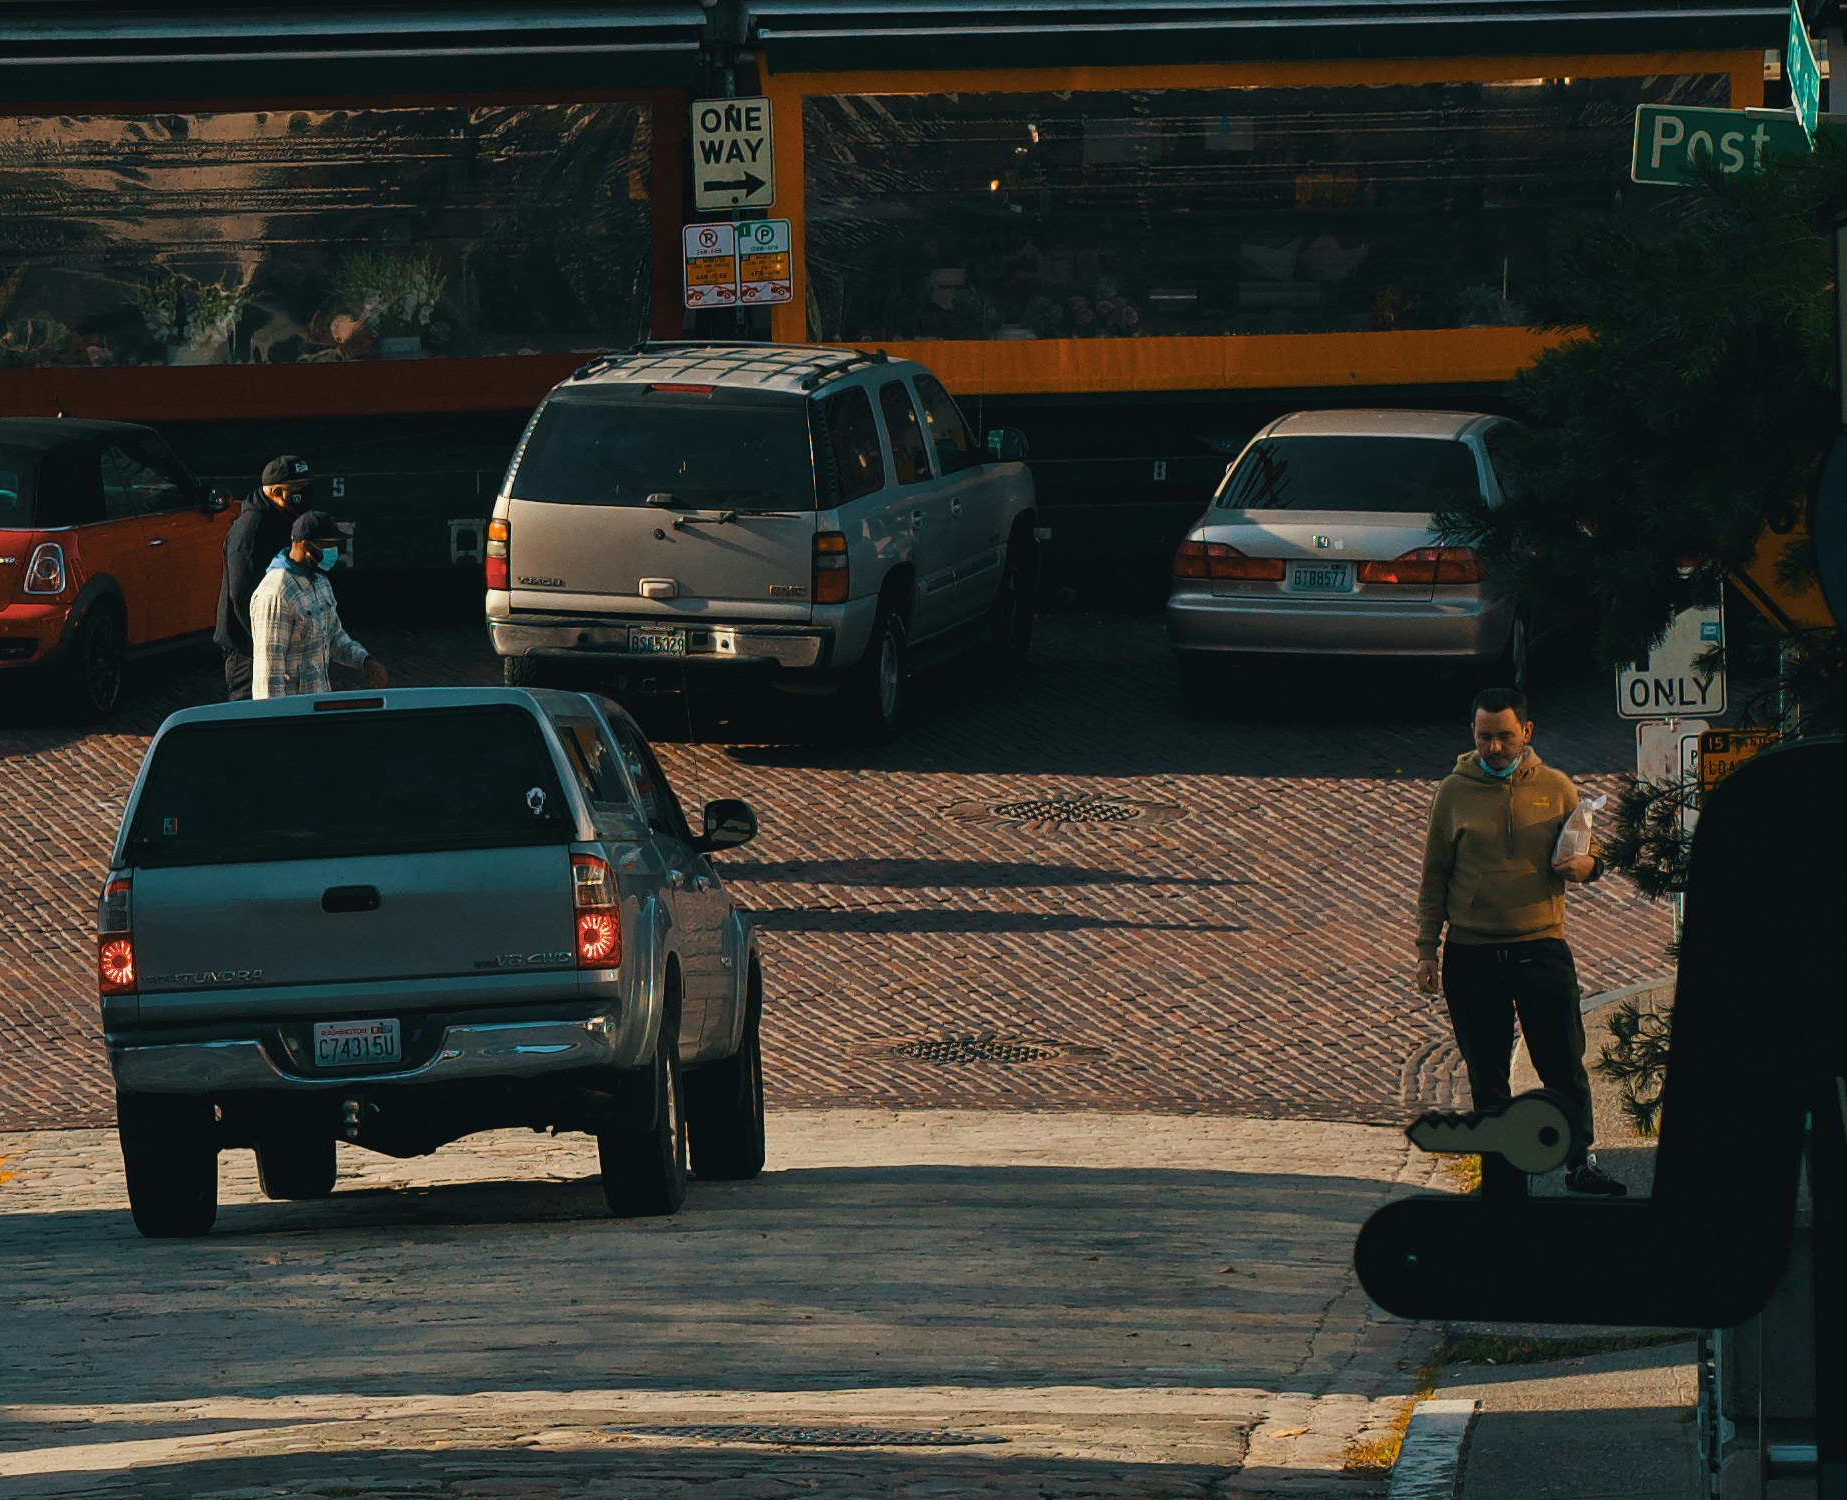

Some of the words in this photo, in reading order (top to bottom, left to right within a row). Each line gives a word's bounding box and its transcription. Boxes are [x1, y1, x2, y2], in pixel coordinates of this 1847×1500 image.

[700, 106, 762, 134] ONE
[699, 138, 764, 165] WAY
[1651, 115, 1771, 175] Post
[332, 476, 345, 498] 5
[1629, 676, 1715, 707] ONLY
[1708, 735, 1725, 751] 15
[176, 968, 264, 984] TUNDRA
[318, 1035, 395, 1061] C74315U
